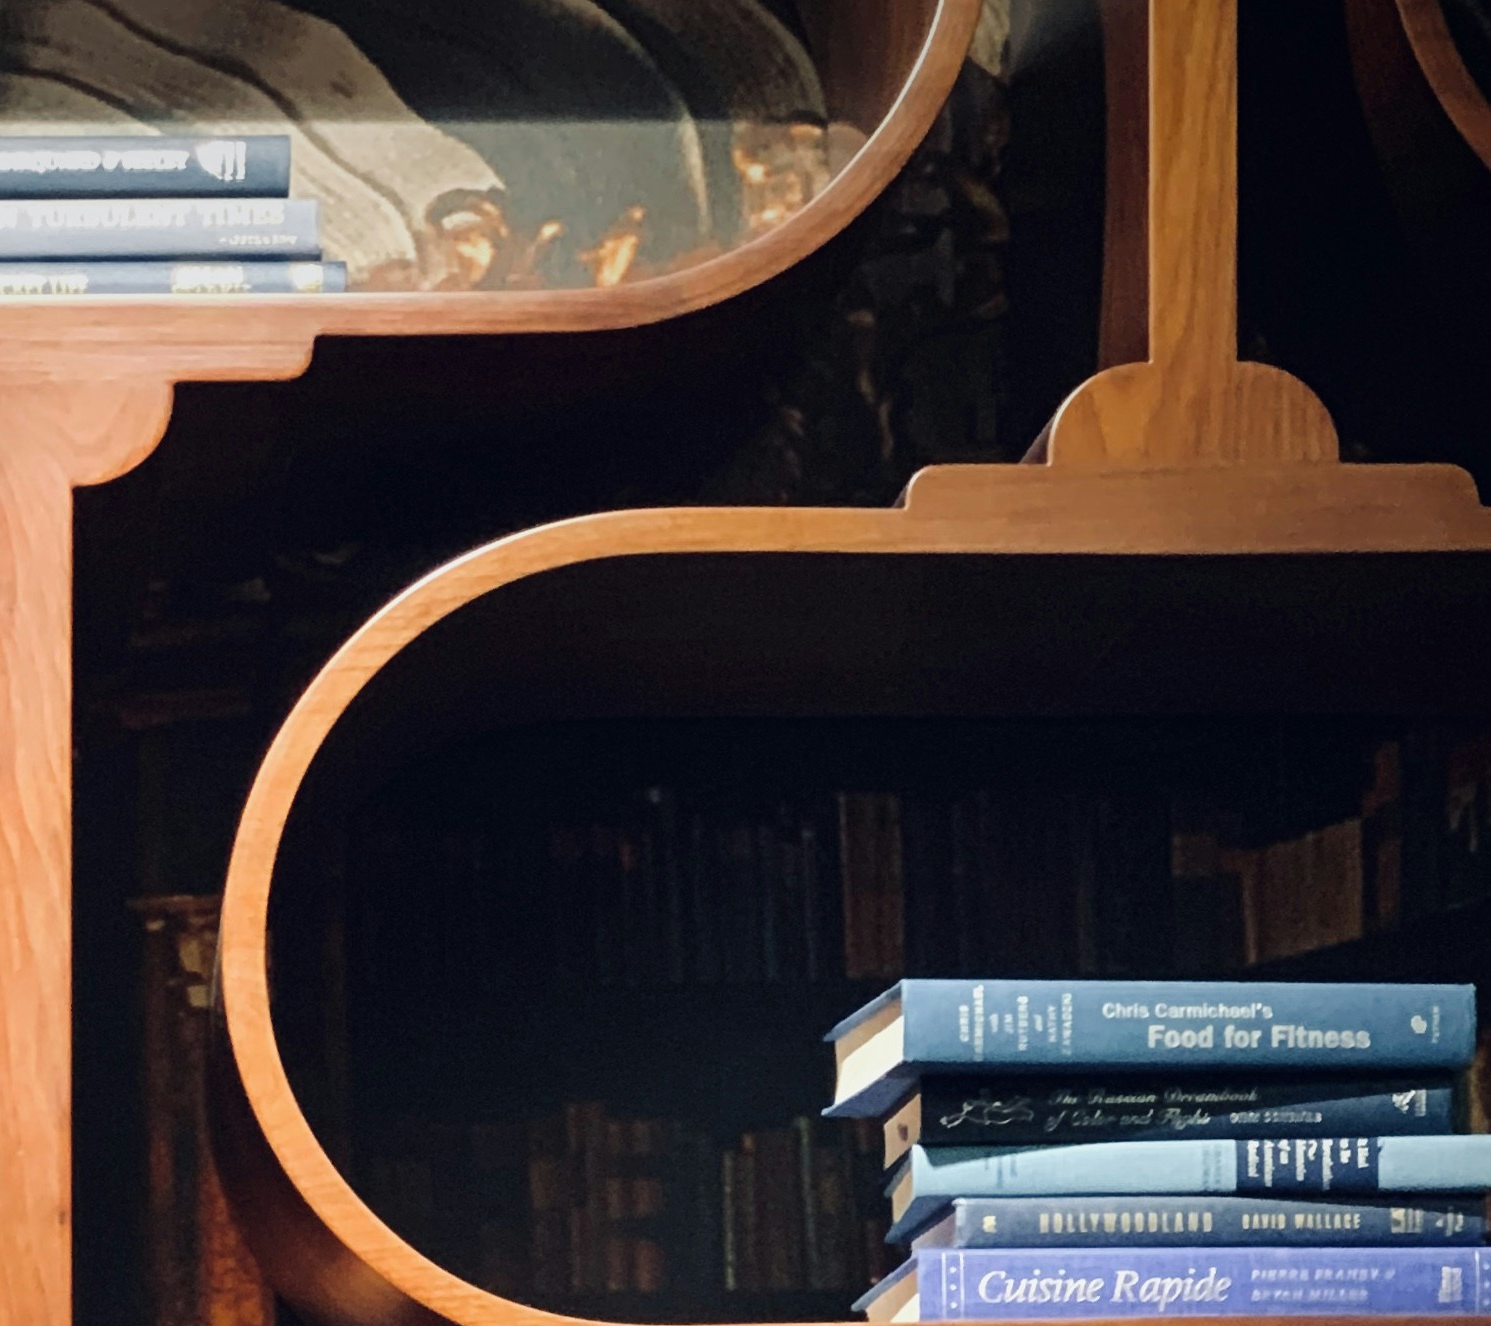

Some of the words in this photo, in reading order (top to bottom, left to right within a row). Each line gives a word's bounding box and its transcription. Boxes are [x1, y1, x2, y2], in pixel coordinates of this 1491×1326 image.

[30, 205, 188, 228] TURBULENT
[203, 204, 286, 226] TIMES
[1102, 1002, 1149, 1019] Chris
[1155, 1002, 1273, 1020] Carmichael's
[1148, 1024, 1214, 1049] Food
[1224, 1024, 1261, 1049] for
[1271, 1025, 1371, 1050] Fitness
[1039, 1211, 1213, 1234] HOLLYWOODLAND
[1242, 1212, 1286, 1230] DAVID
[1293, 1212, 1362, 1230] WALLACE
[978, 1268, 1104, 1304] Cuisine
[1110, 1265, 1233, 1312] Rapide
